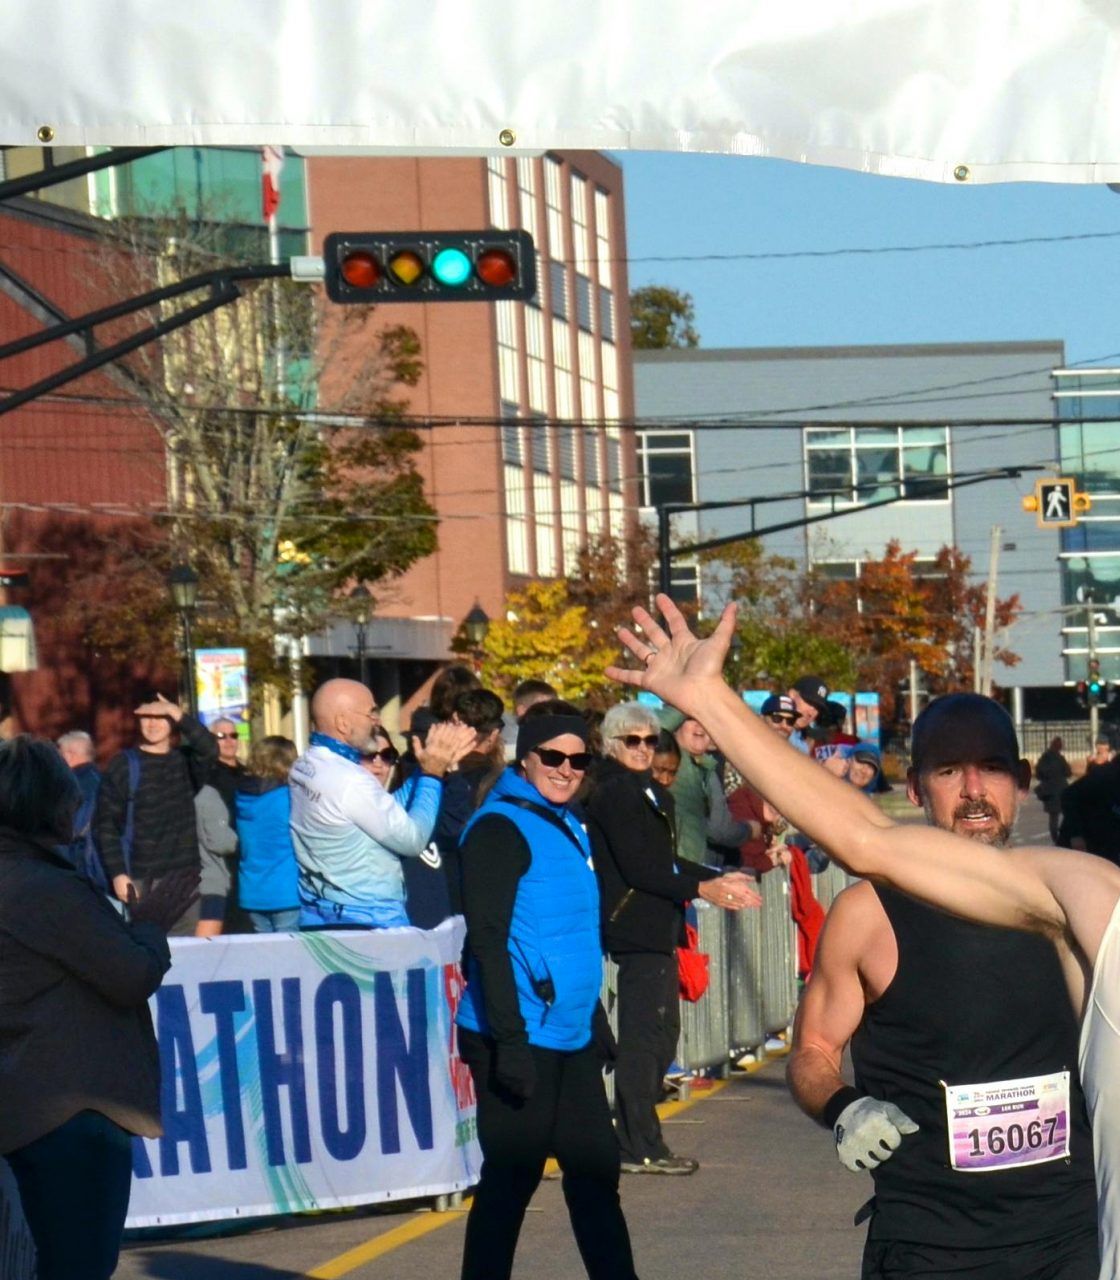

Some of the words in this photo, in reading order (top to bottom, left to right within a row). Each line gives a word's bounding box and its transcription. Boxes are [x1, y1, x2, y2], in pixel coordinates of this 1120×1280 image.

[132, 967, 435, 1180] ATHON
[986, 1088, 1035, 1102] MARATHON
[968, 1117, 1058, 1157] 16067
